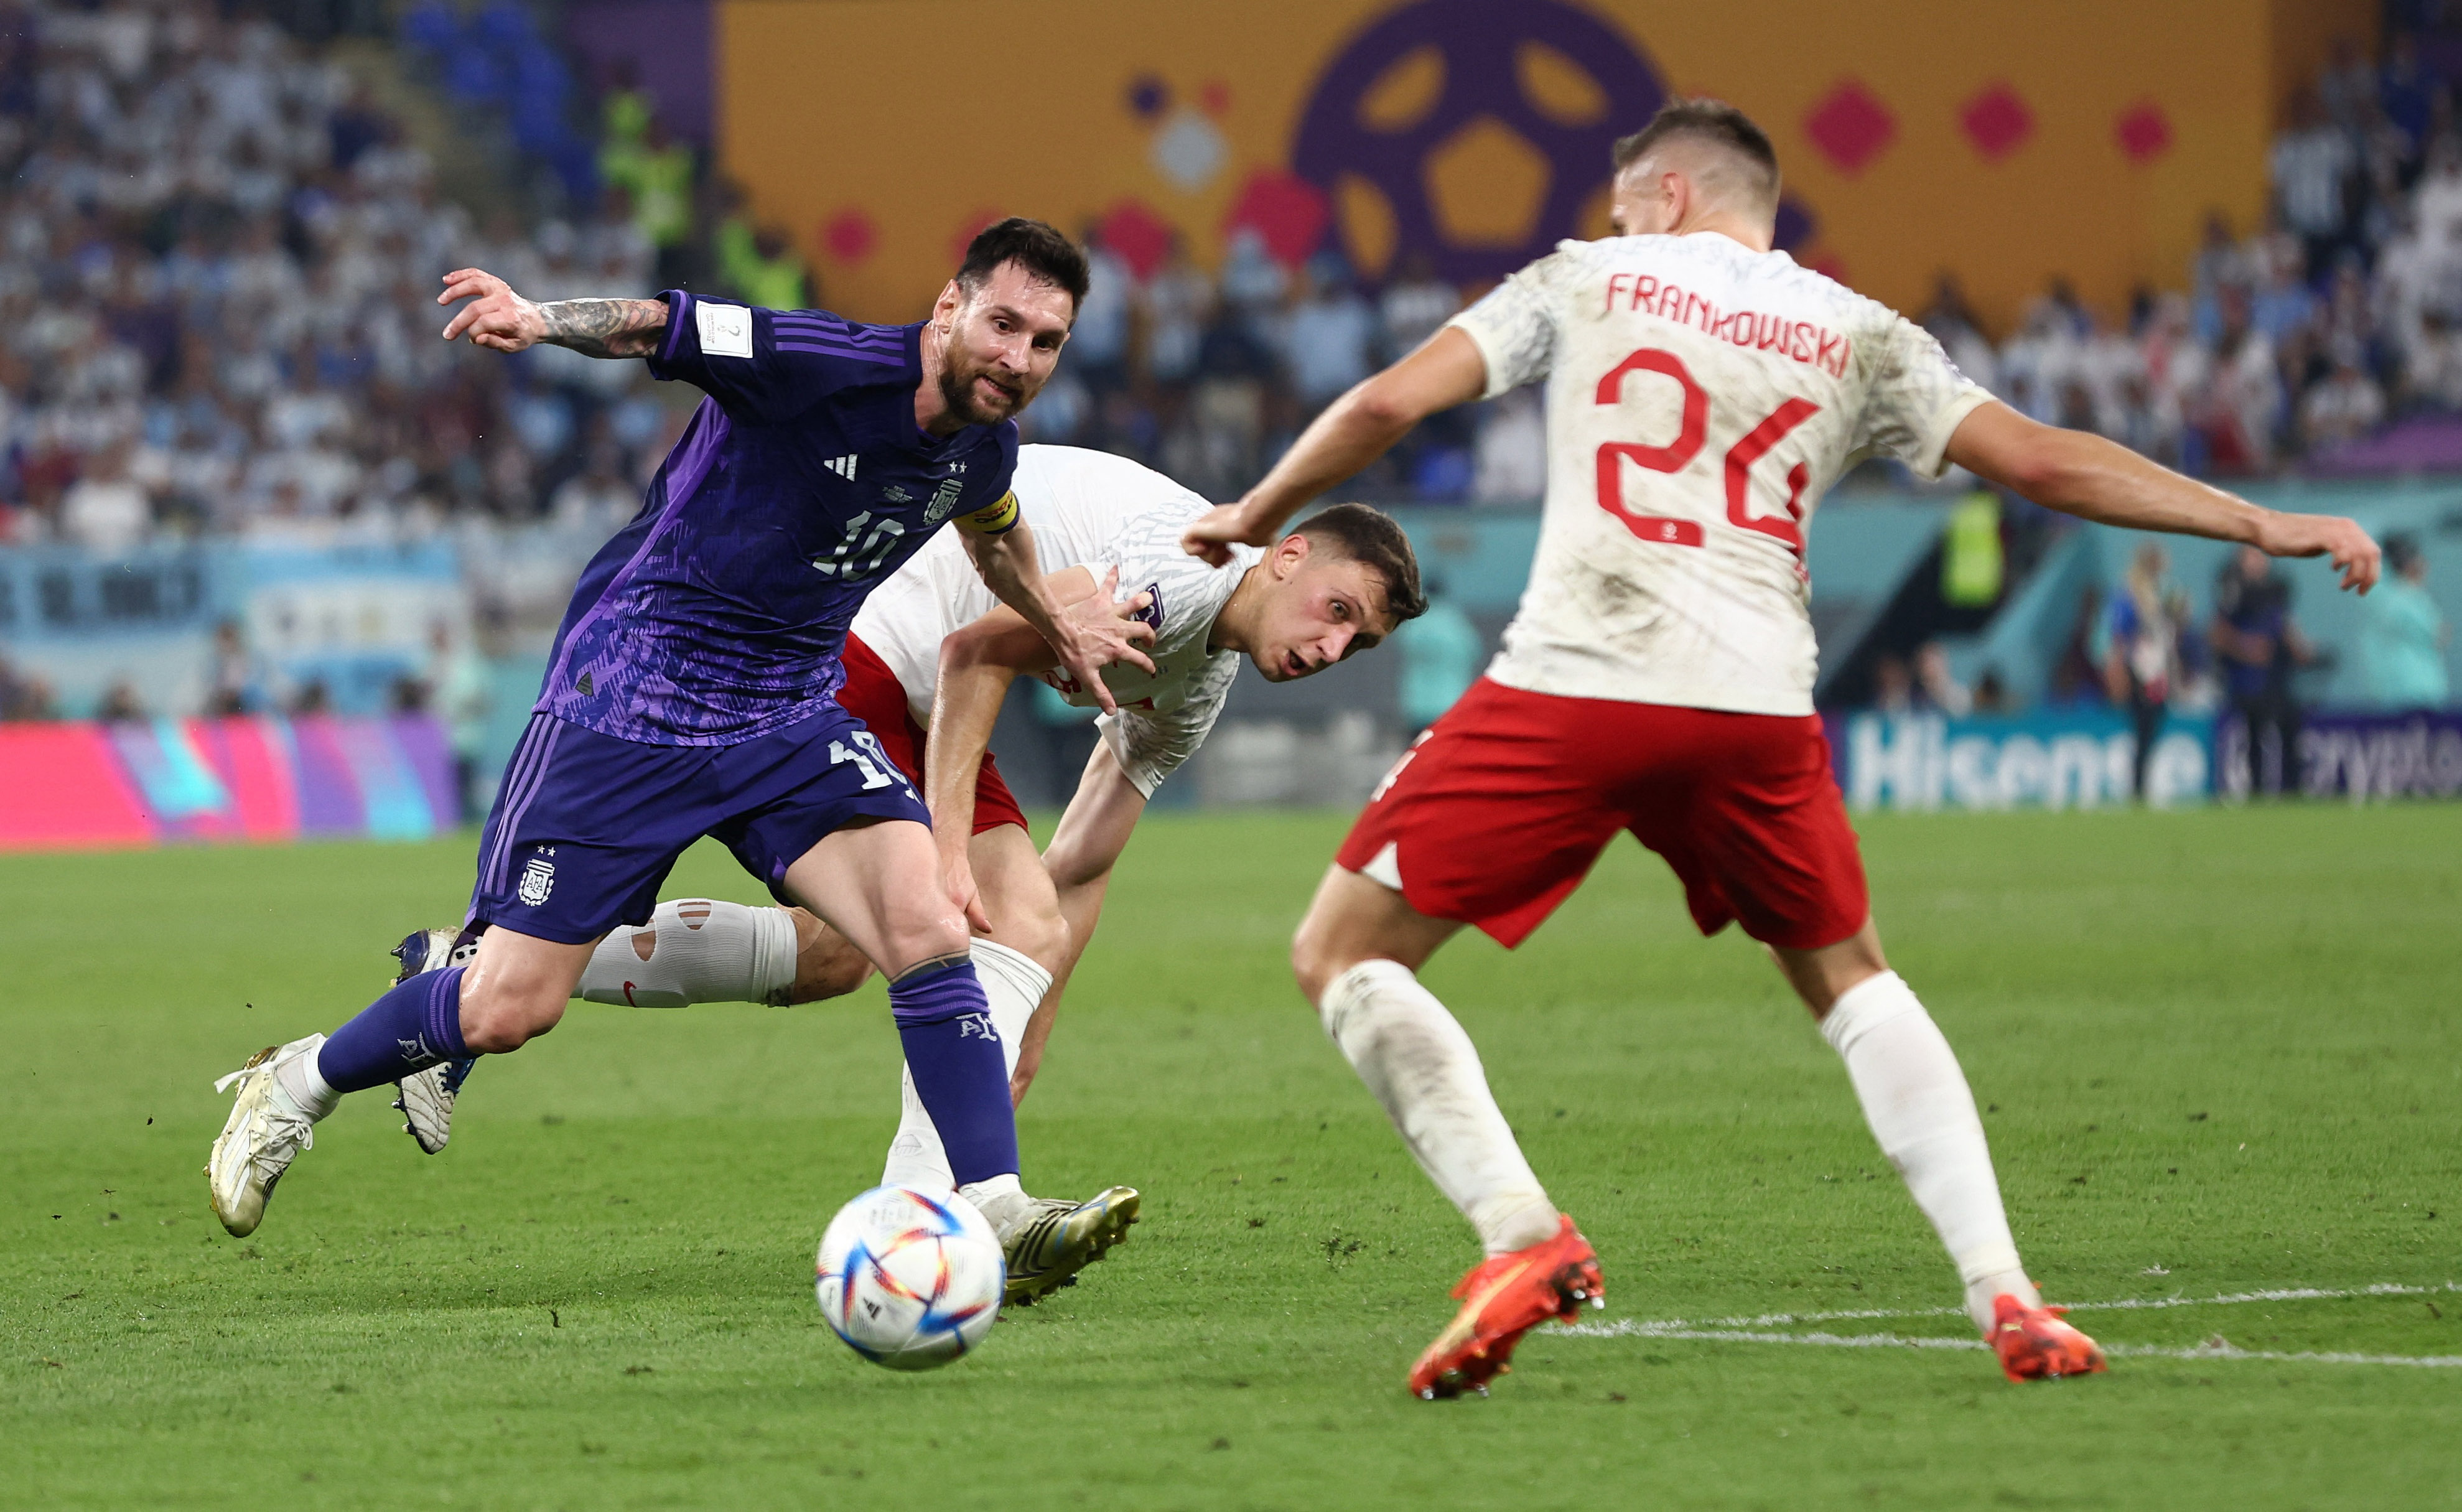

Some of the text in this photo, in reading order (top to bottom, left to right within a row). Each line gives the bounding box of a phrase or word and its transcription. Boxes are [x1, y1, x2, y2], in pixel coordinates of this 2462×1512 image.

[1606, 273, 1852, 380] FRANKOWSKI
[813, 510, 905, 582] 10
[827, 730, 924, 807] 10
